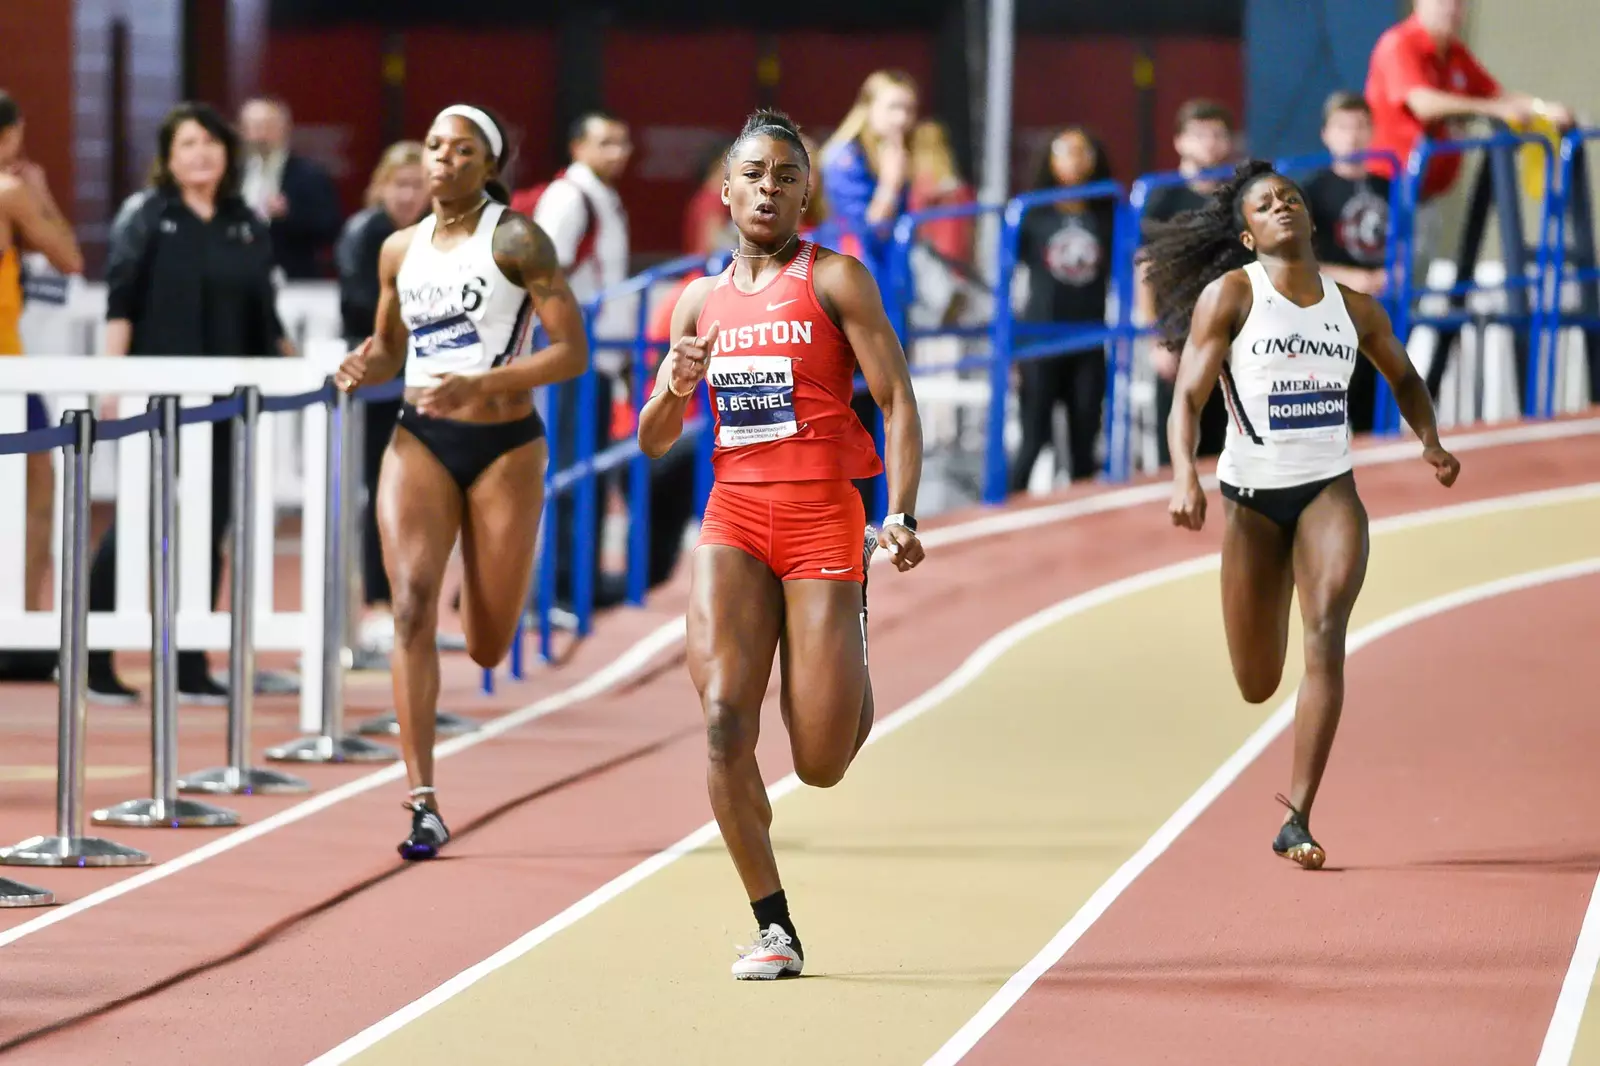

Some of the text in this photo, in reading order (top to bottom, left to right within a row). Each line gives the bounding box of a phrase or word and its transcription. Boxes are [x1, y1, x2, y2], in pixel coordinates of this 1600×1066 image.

[462, 276, 486, 312] 6
[711, 320, 812, 356] USTON
[1252, 338, 1355, 363] CINCINNATI
[712, 372, 786, 386] AMERICAN
[1271, 380, 1342, 393] AMERIAN
[716, 393, 791, 411] B. BETHEL
[1270, 399, 1344, 418] ROBINSON
